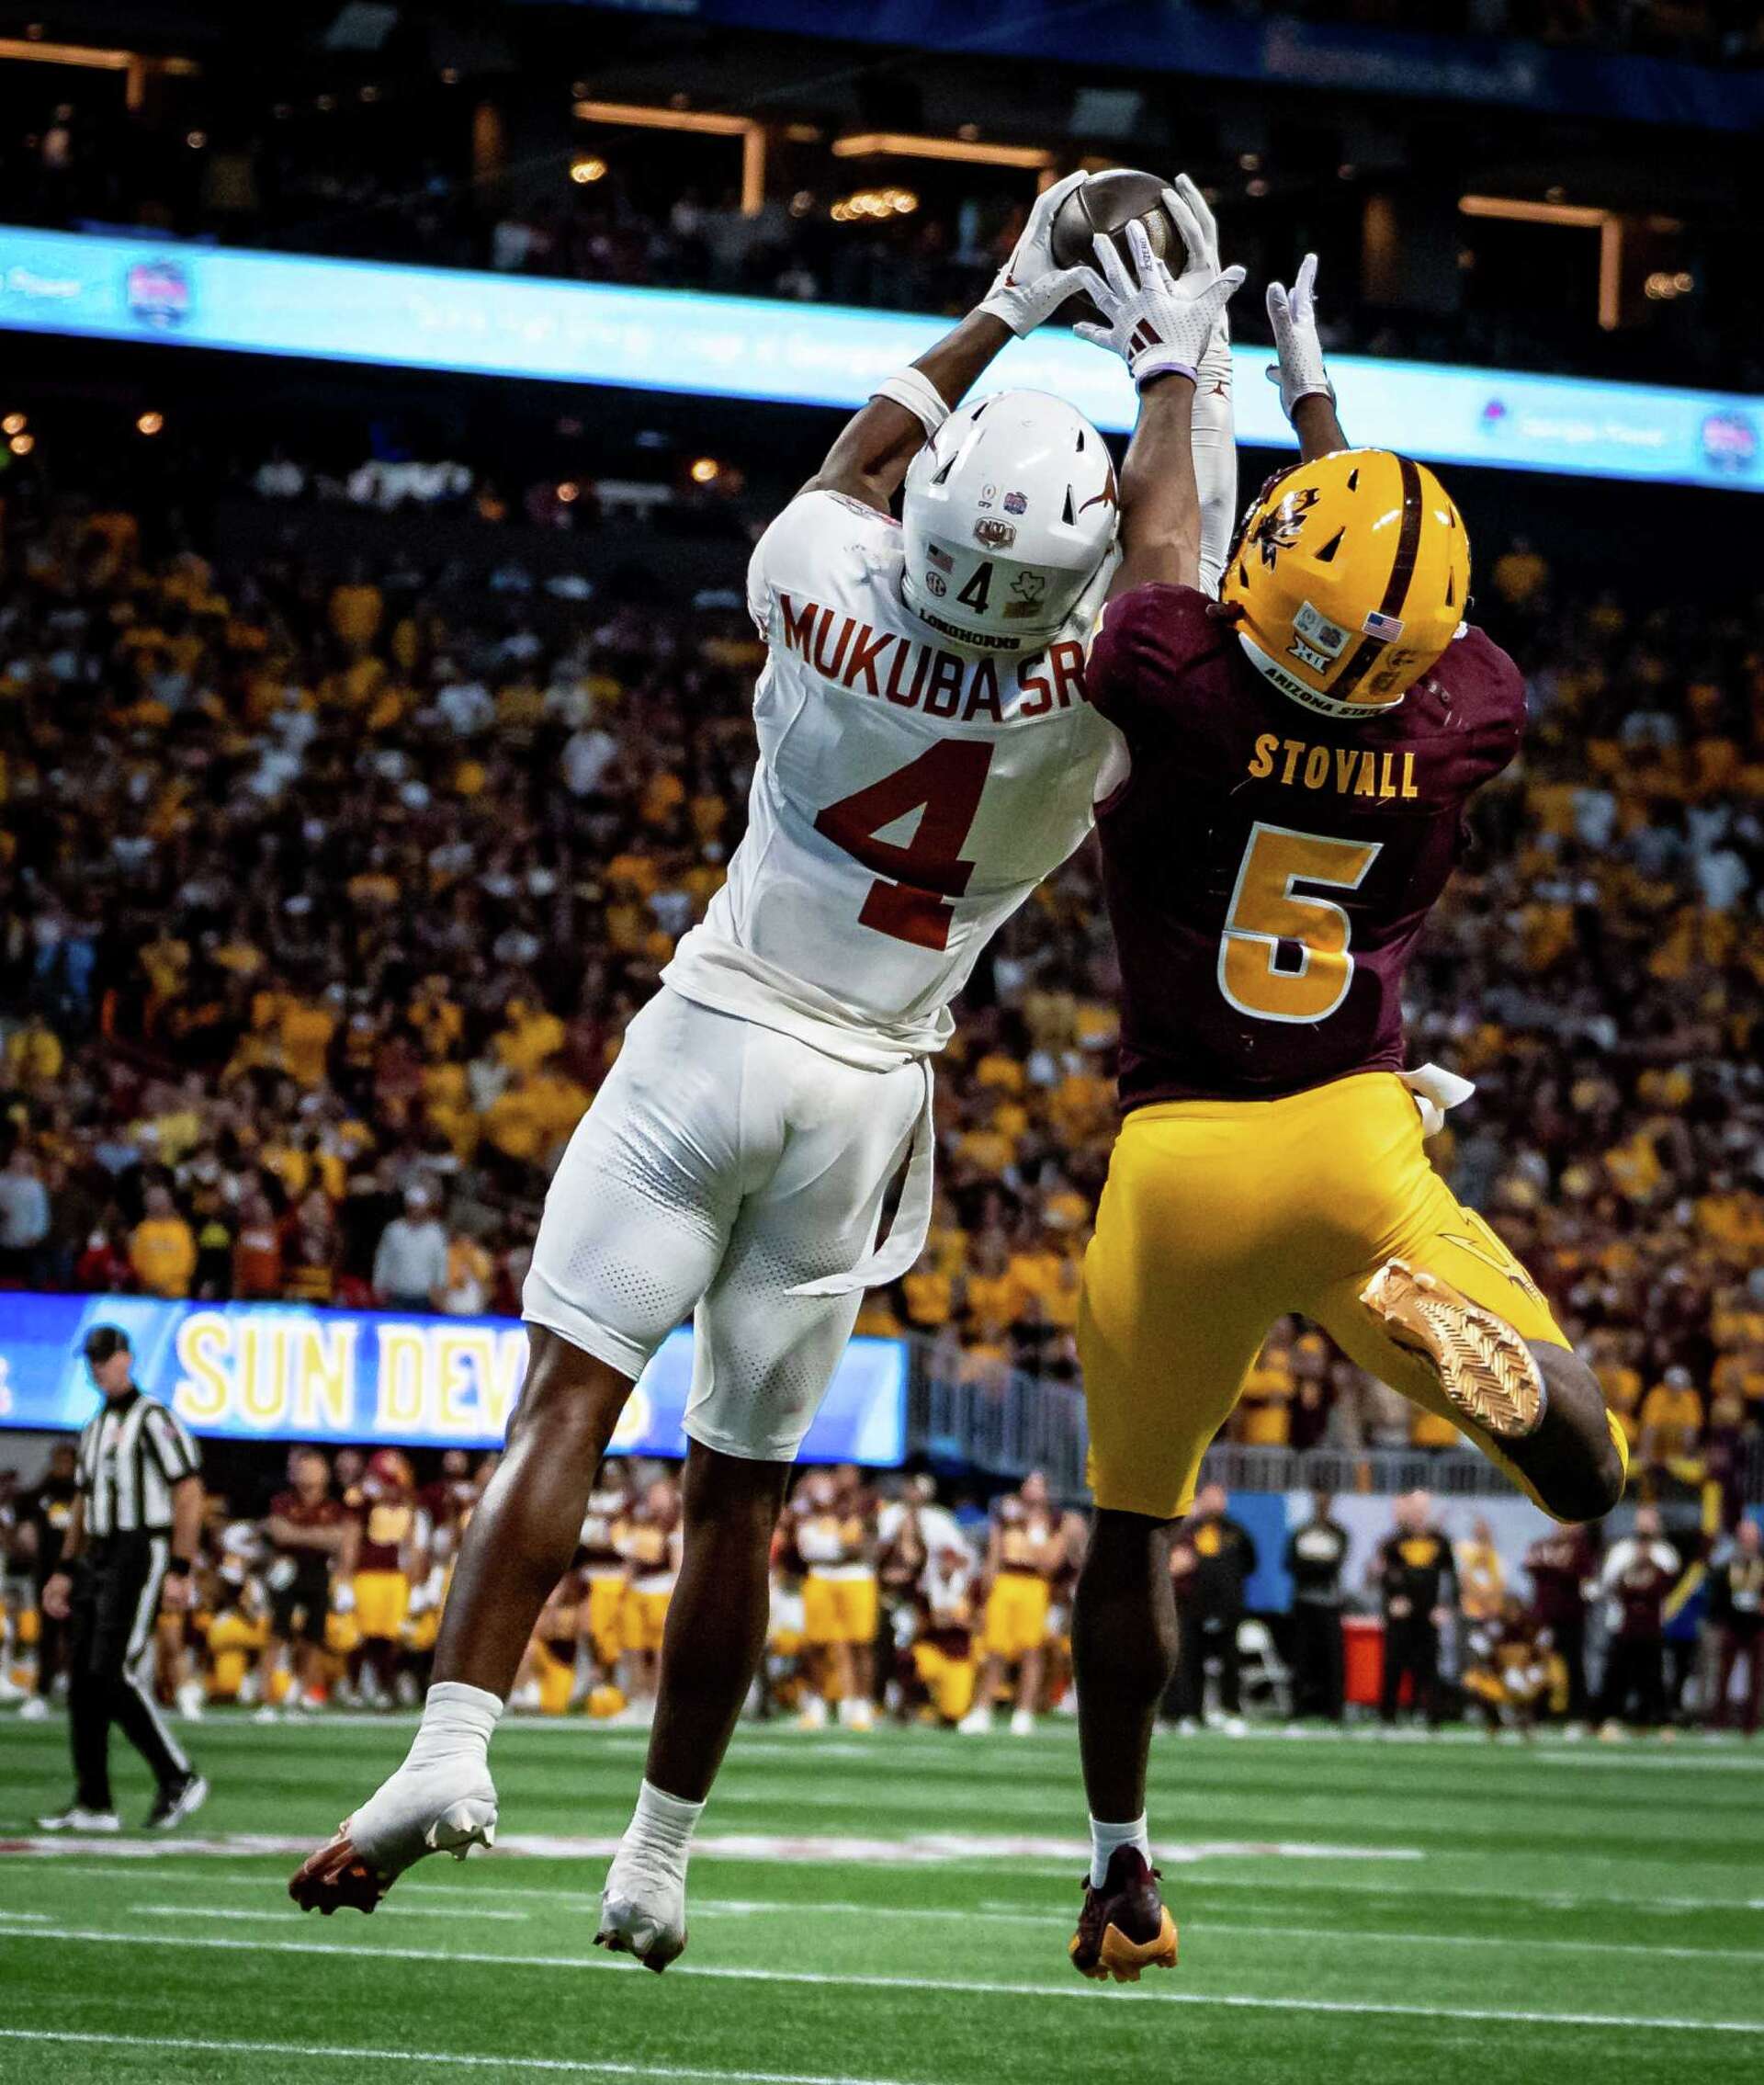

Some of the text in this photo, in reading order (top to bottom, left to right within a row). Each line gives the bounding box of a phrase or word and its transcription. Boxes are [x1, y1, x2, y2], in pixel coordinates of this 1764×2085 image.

[919, 607, 1021, 649] LONGHORNS
[956, 561, 993, 614] 4
[780, 594, 1088, 722] MUKUBA SR
[1264, 667, 1334, 712] ARIZONA
[1248, 733, 1418, 798] STOVALL
[813, 738, 994, 951] 4
[1217, 821, 1385, 1025] 5
[175, 1311, 358, 1424] SUN
